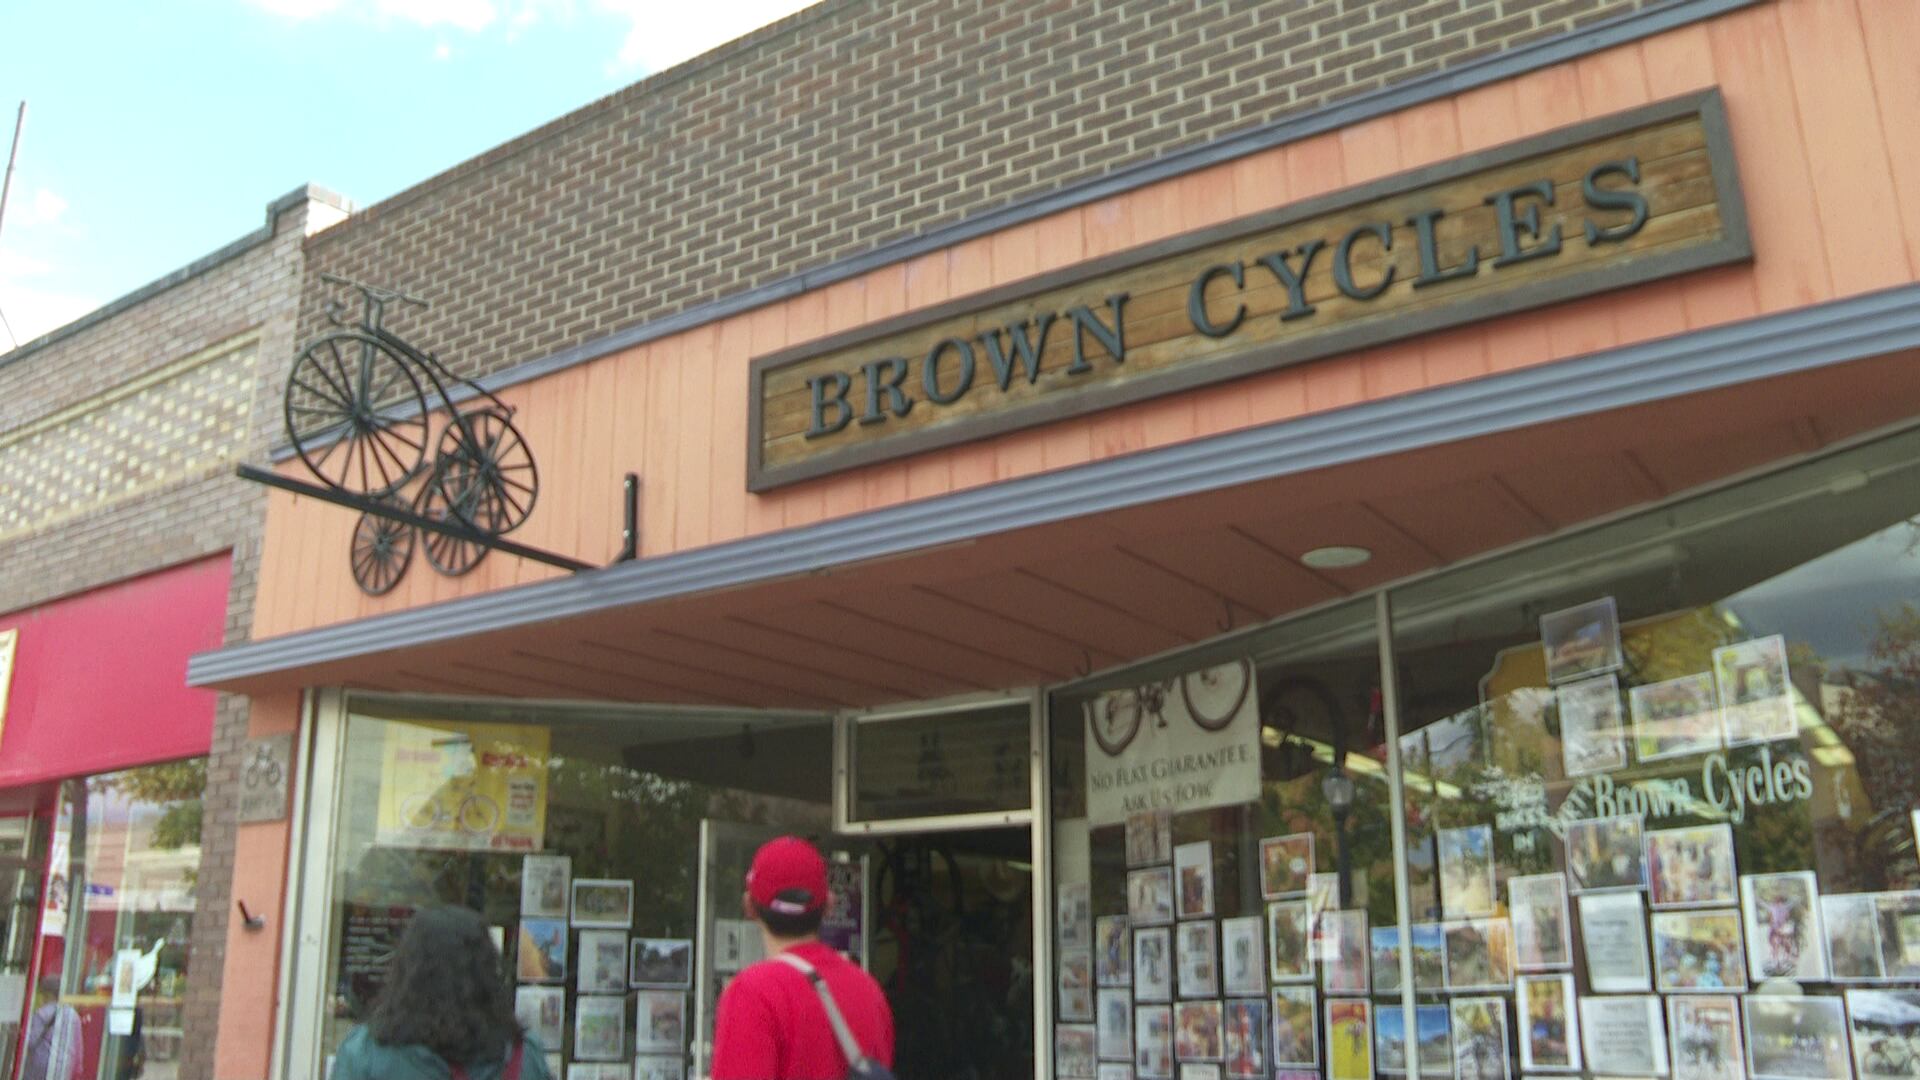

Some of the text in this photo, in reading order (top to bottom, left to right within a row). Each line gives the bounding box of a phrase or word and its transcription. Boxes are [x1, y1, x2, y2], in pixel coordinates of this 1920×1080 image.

[805, 155, 1653, 441] BROWN CYCLES
[1594, 773, 1691, 818] Brown
[1703, 744, 1813, 825] Cycles
